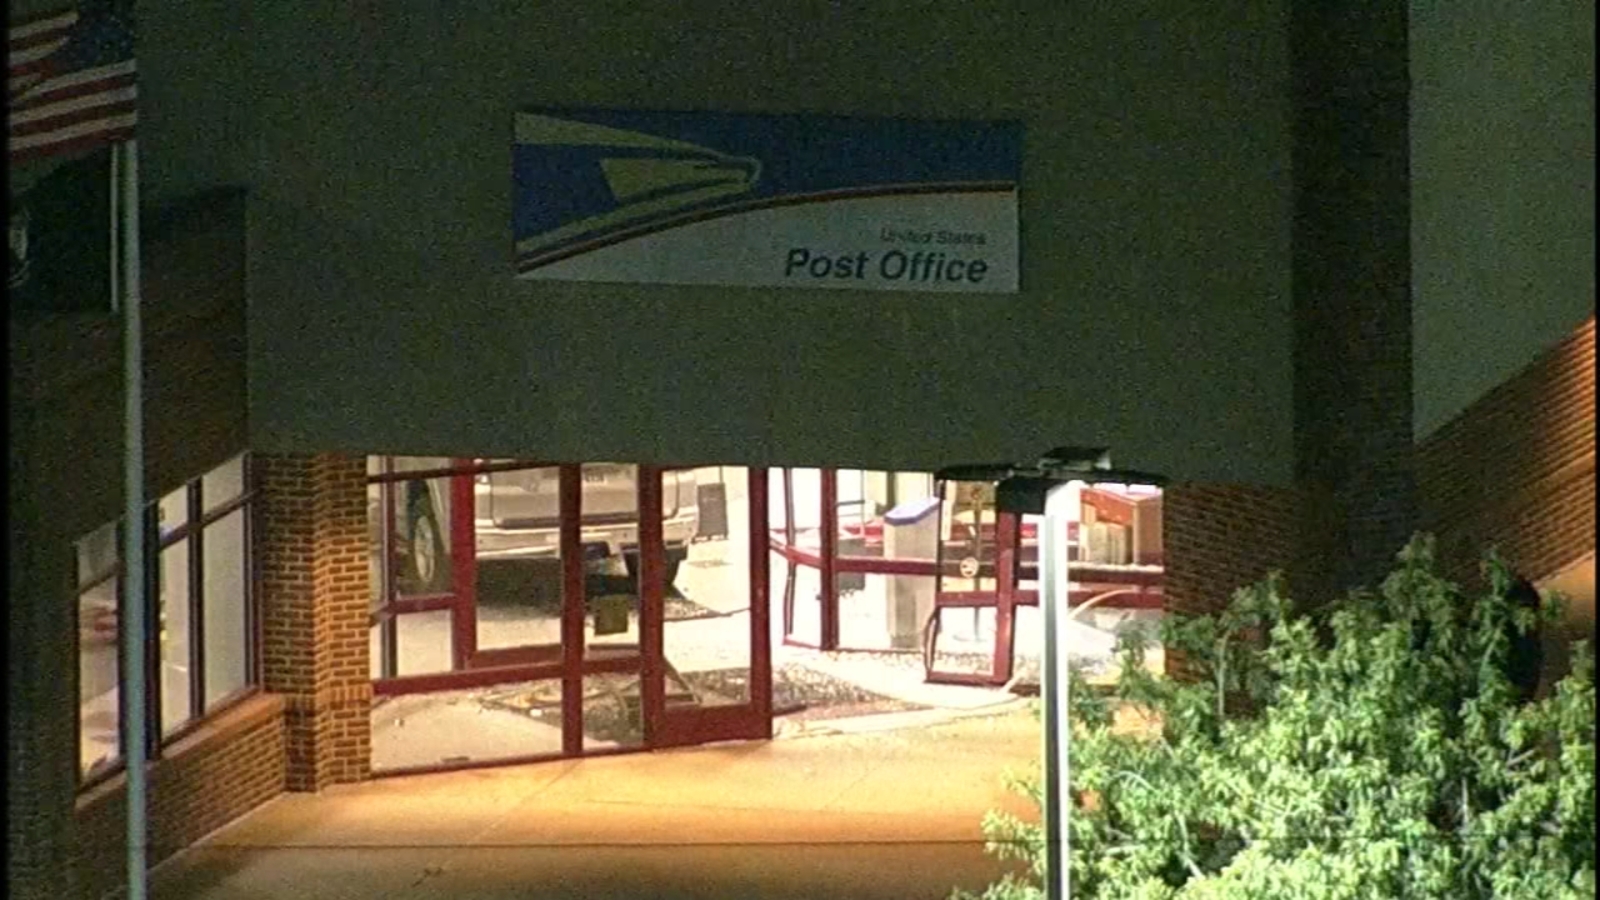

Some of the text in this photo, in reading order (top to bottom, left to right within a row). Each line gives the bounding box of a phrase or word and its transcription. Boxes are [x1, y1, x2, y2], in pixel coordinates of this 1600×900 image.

[880, 227, 987, 245] United States
[784, 248, 988, 282] Post Office
